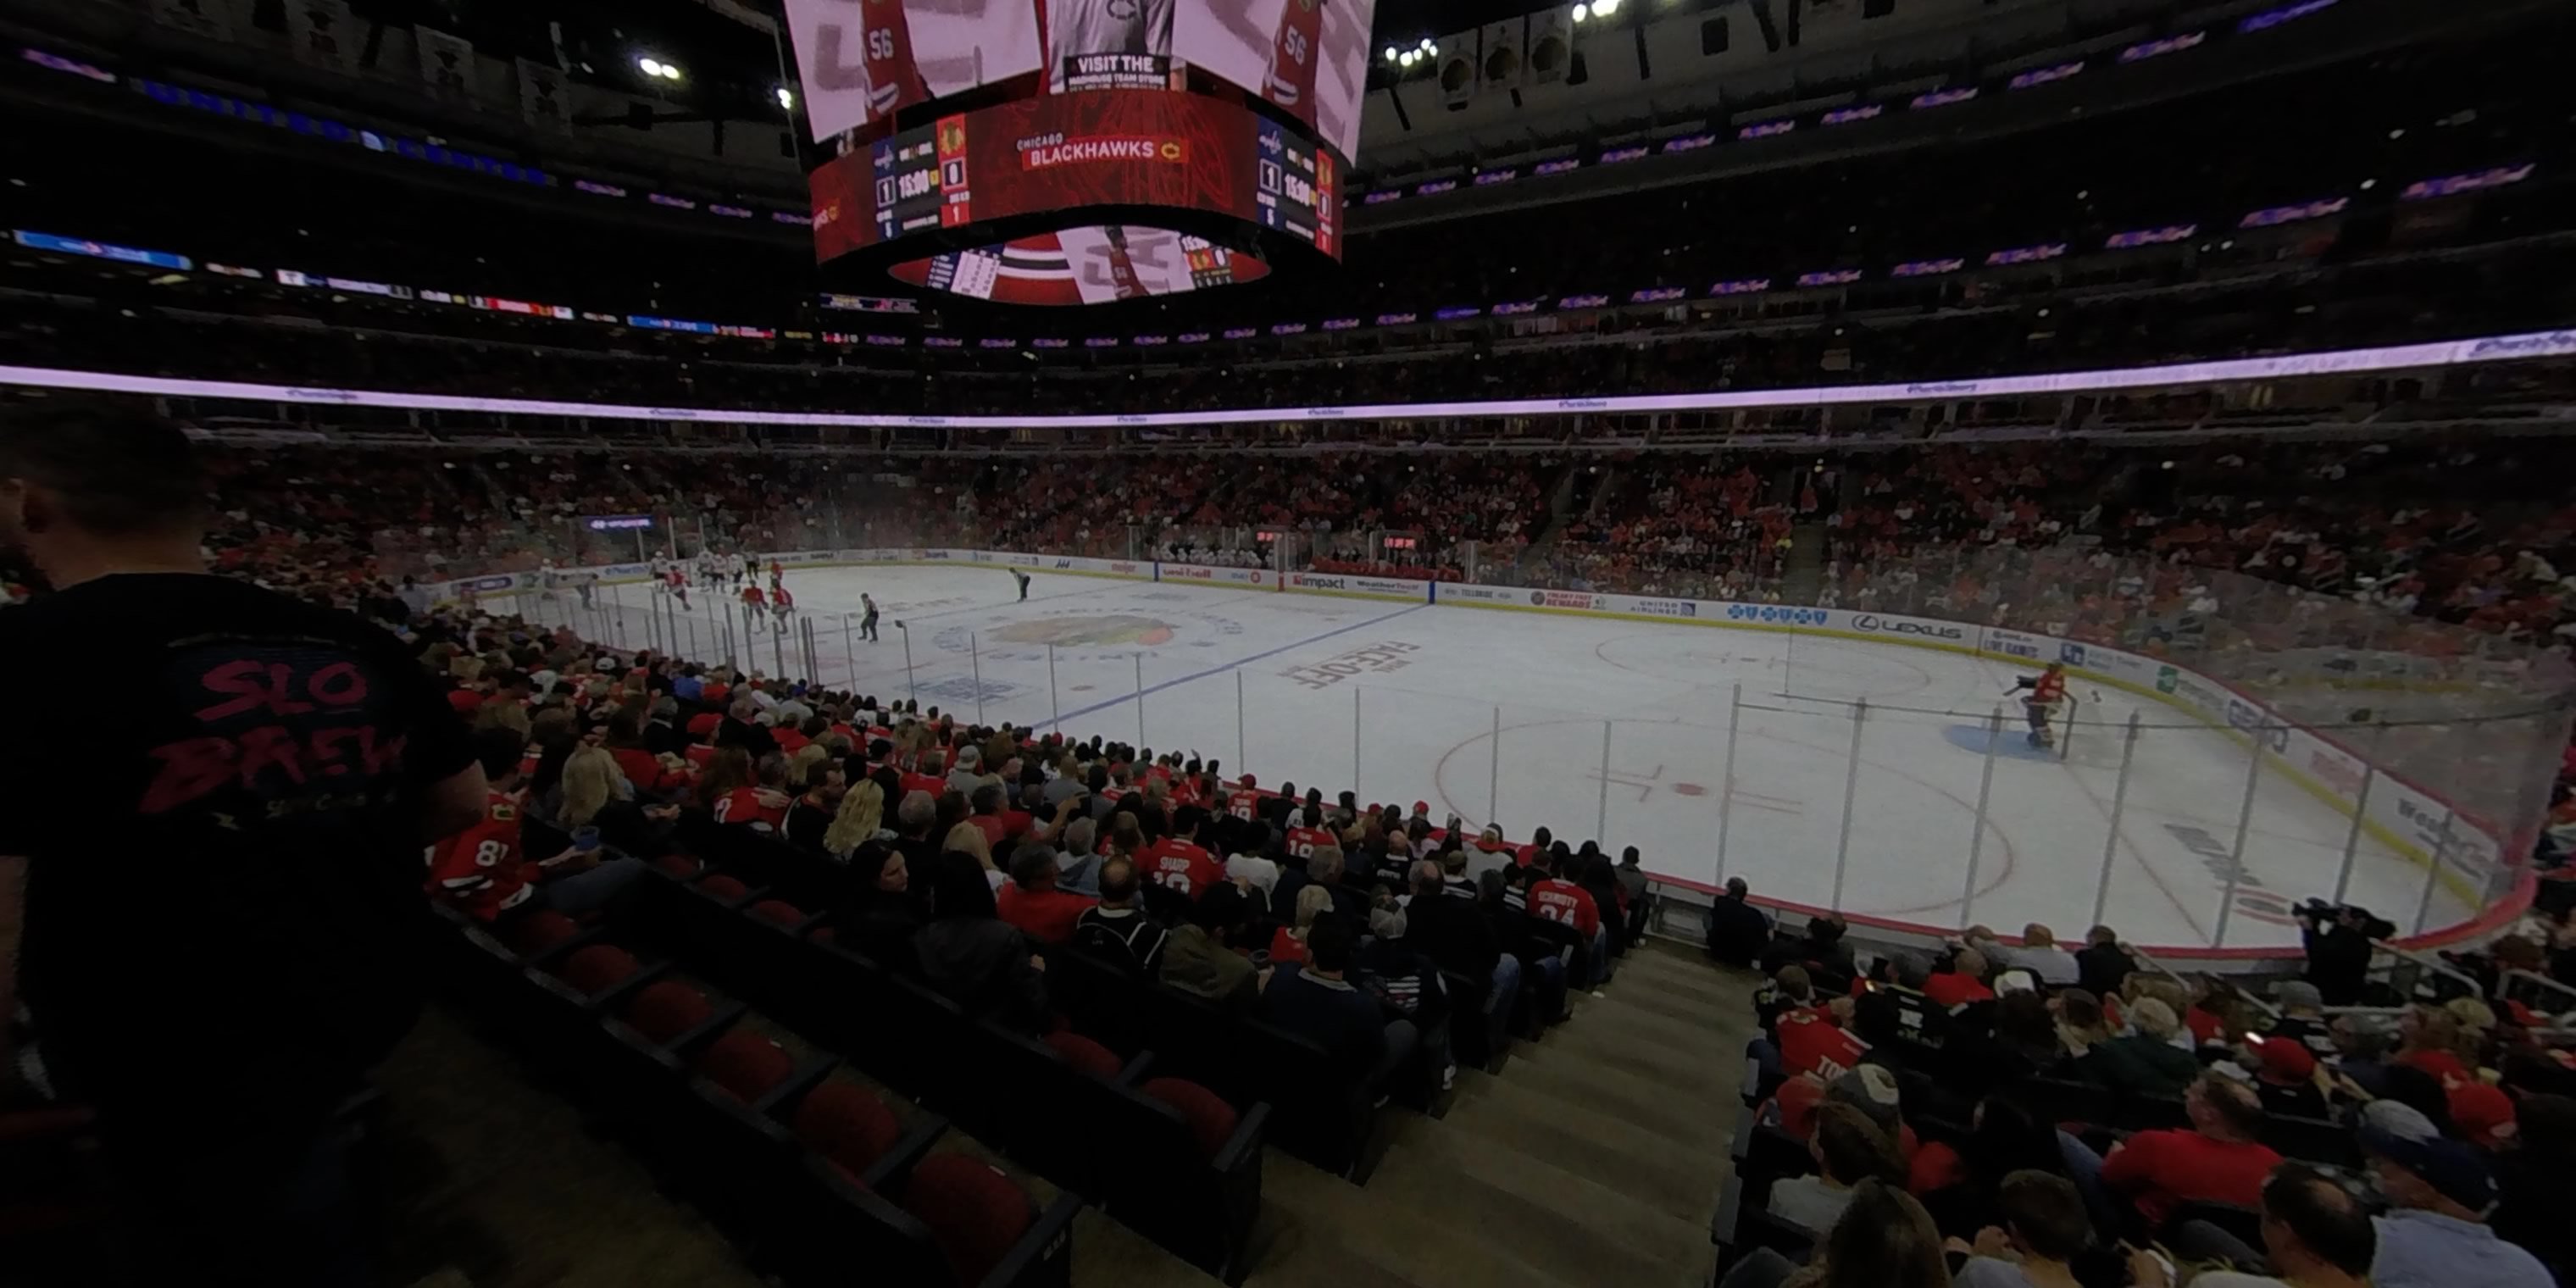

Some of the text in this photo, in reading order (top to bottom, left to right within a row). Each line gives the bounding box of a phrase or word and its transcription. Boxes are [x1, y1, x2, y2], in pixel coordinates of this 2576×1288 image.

[869, 27, 894, 61] 56
[1284, 25, 1307, 66] 56
[1078, 55, 1154, 74] VISIT THE
[1017, 132, 1063, 152] CHICAGO
[1030, 141, 1154, 167] BLACKHAWKS
[1302, 575, 1346, 590] impact
[1545, 598, 1591, 610] REWARDS
[1630, 606, 1678, 615] AIRLINES
[1639, 600, 1679, 608] UNITED
[1877, 620, 1963, 640] LEXUS
[192, 658, 369, 723] SLO
[1158, 855, 1191, 874] SHARP
